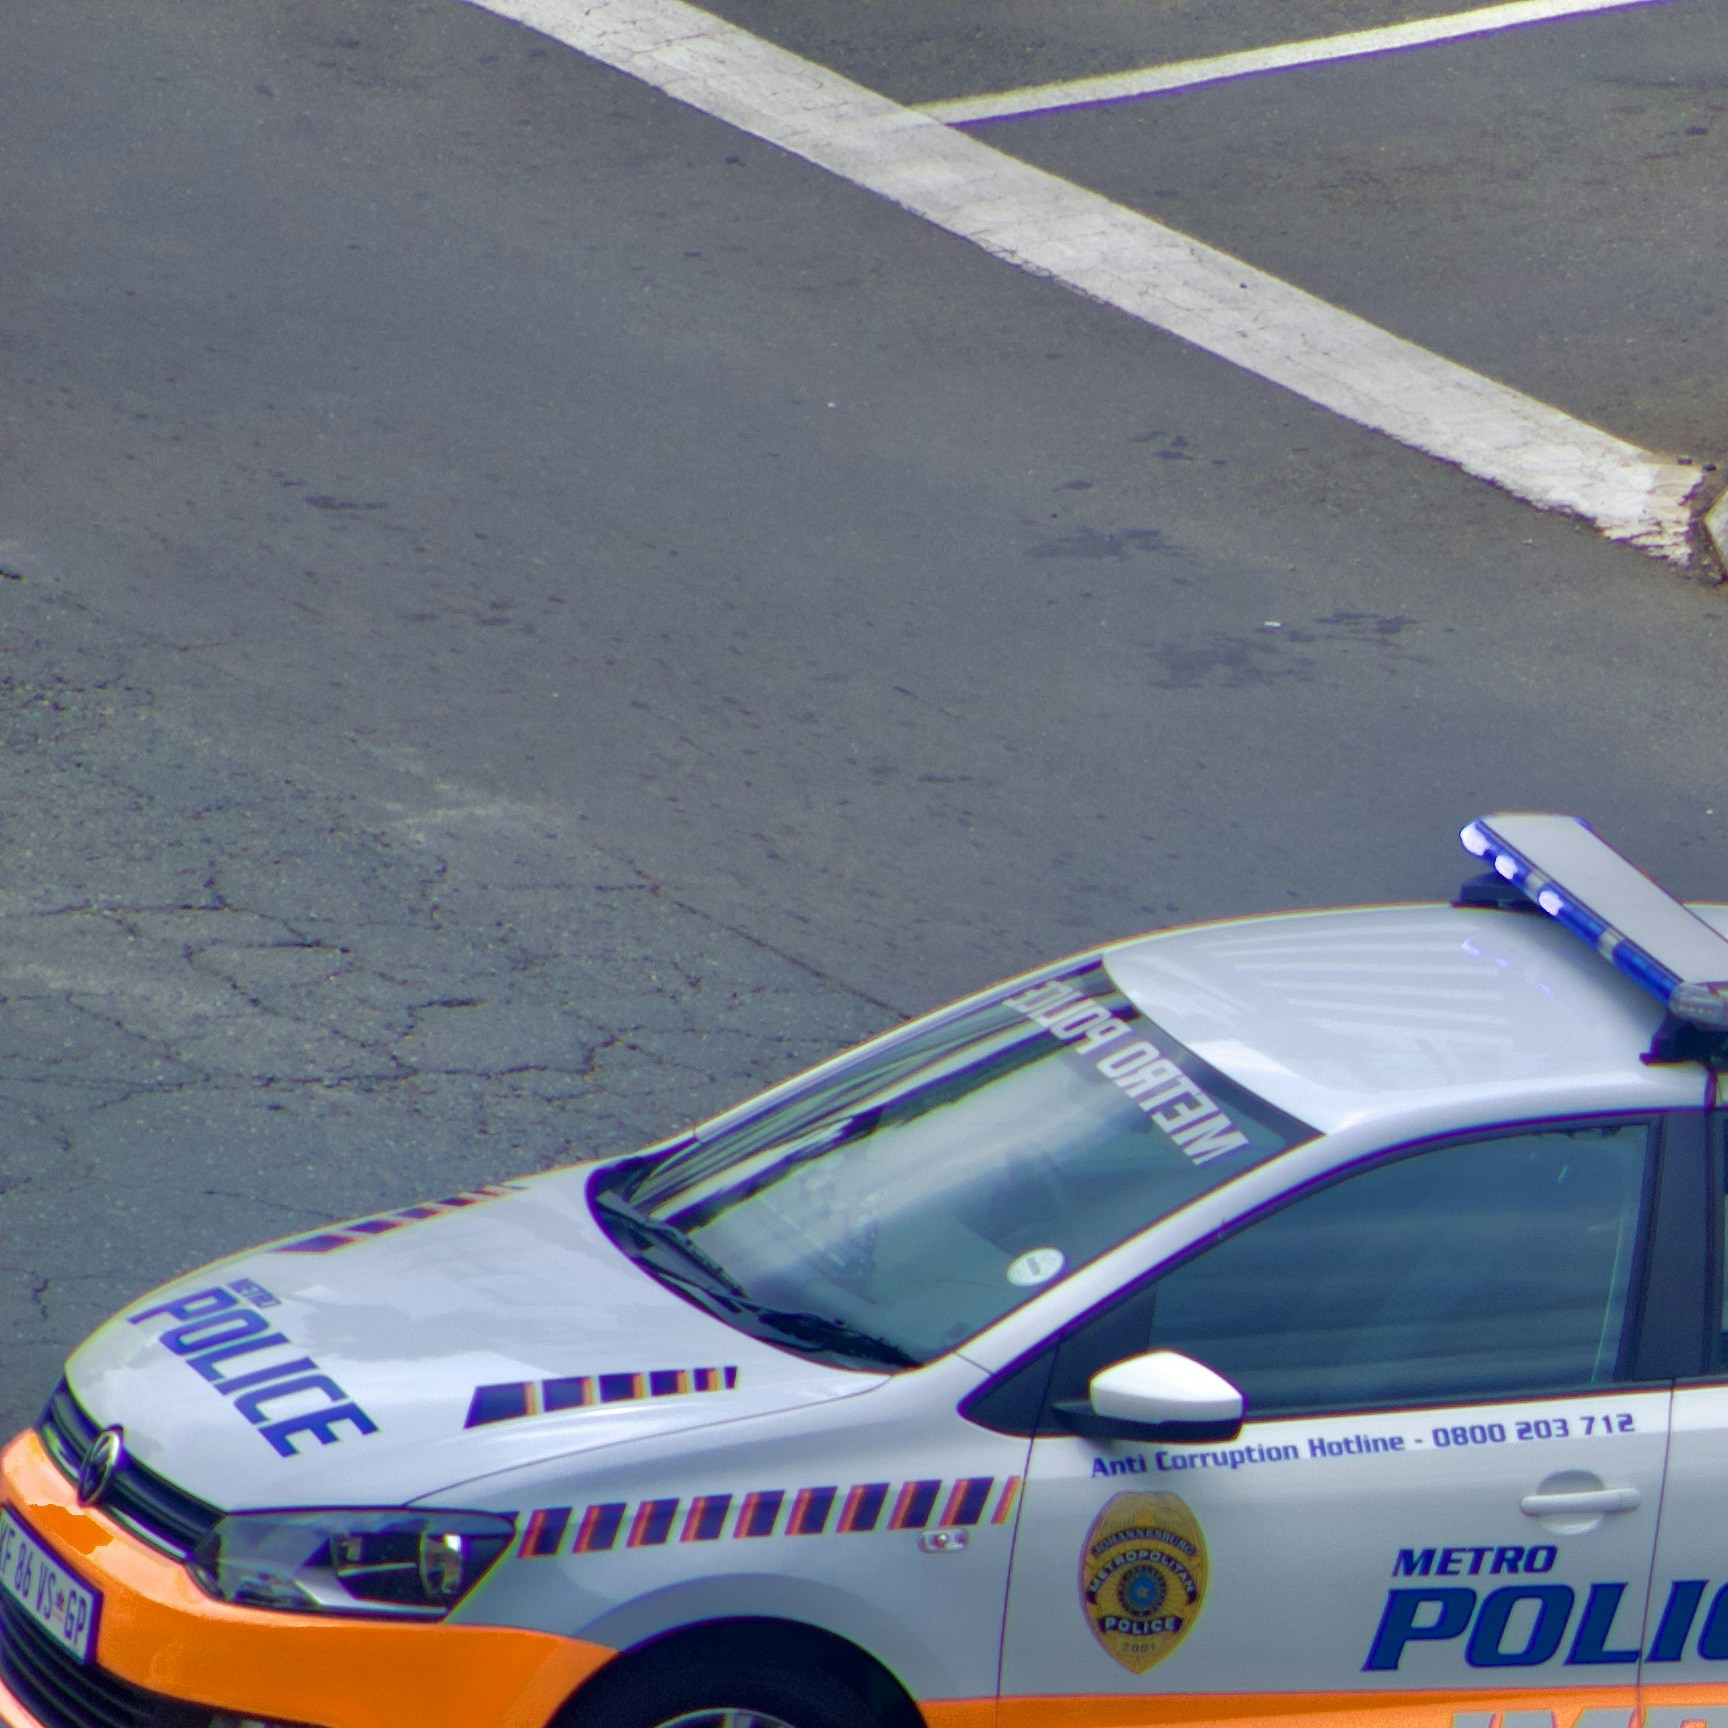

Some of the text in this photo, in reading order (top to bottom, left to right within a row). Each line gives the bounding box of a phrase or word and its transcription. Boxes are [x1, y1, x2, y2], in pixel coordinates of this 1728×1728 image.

[127, 1286, 379, 1457] POLICE
[1090, 1455, 1146, 1479] Anti
[1156, 1441, 1299, 1473] Corruption
[1308, 1432, 1405, 1460] Hotline
[1432, 1423, 1506, 1449] 0800
[1516, 1418, 1570, 1441] 203
[1581, 1413, 1636, 1437] 712
[0, 1525, 15, 1575] F
[64, 1589, 87, 1645] GP
[1089, 1550, 1196, 1592] METROPOLITAN
[1392, 1544, 1558, 1577] METRO
[1104, 1616, 1177, 1635] POLICE
